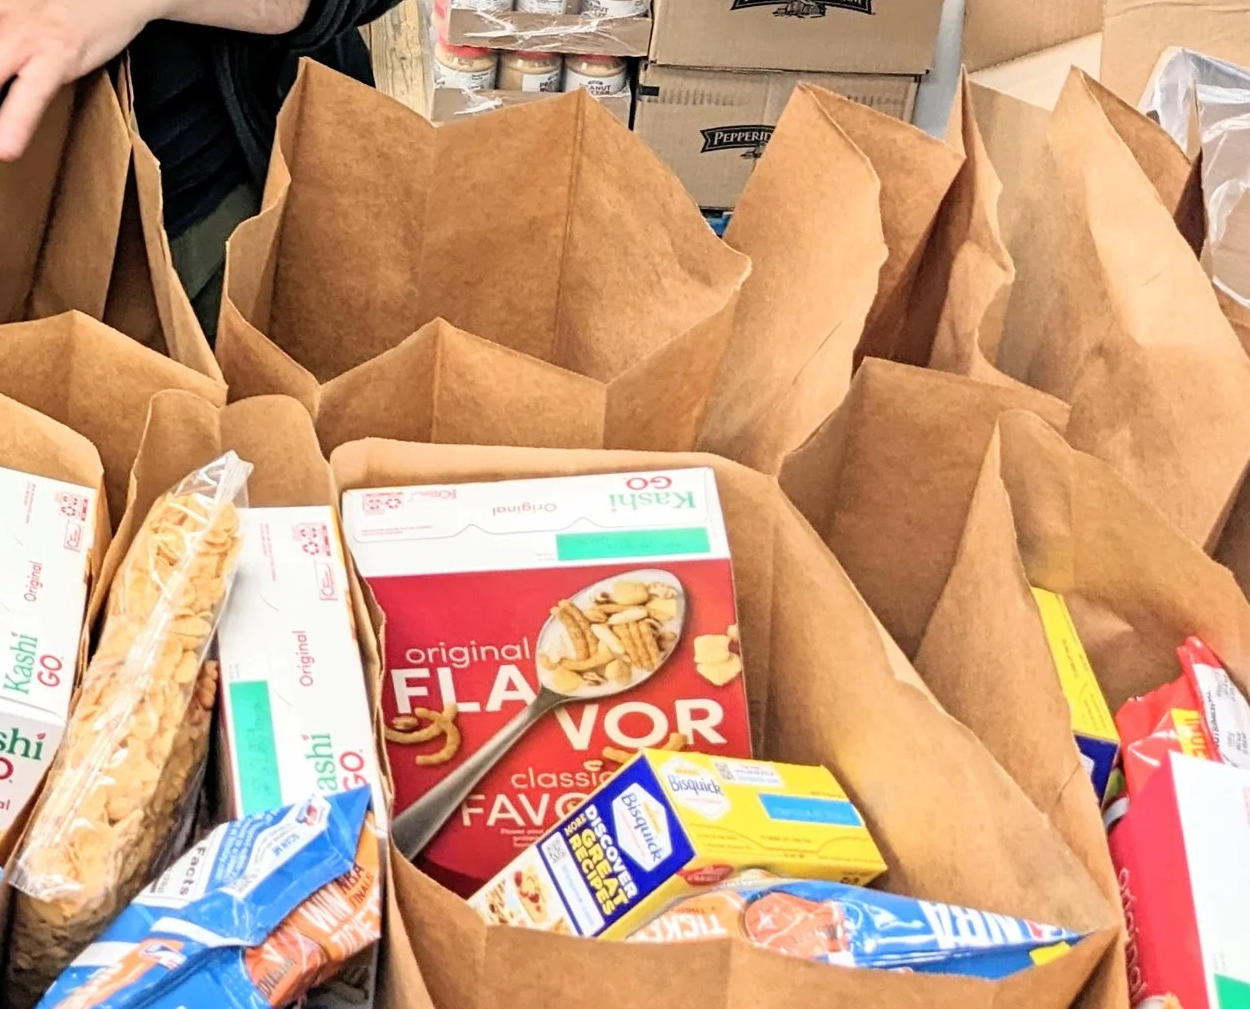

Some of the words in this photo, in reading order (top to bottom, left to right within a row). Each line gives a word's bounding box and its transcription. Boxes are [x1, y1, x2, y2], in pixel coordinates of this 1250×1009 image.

[713, 130, 772, 146] PEPPERID
[609, 491, 696, 513] Kashi
[625, 476, 672, 491] GO
[492, 503, 557, 516] Original
[23, 560, 42, 603] Original
[3, 631, 39, 696] Kashi
[36, 654, 62, 688] GO
[292, 630, 314, 687] Original
[406, 638, 530, 668] original
[301, 733, 338, 791] ashi
[668, 774, 725, 796] Bisquick
[564, 813, 587, 837] MORE
[621, 792, 664, 863] Bisquick
[178, 846, 206, 896] Facts
[582, 828, 630, 907] GREAT
[585, 804, 638, 900] DISCOVER
[569, 833, 616, 916] RECIPES
